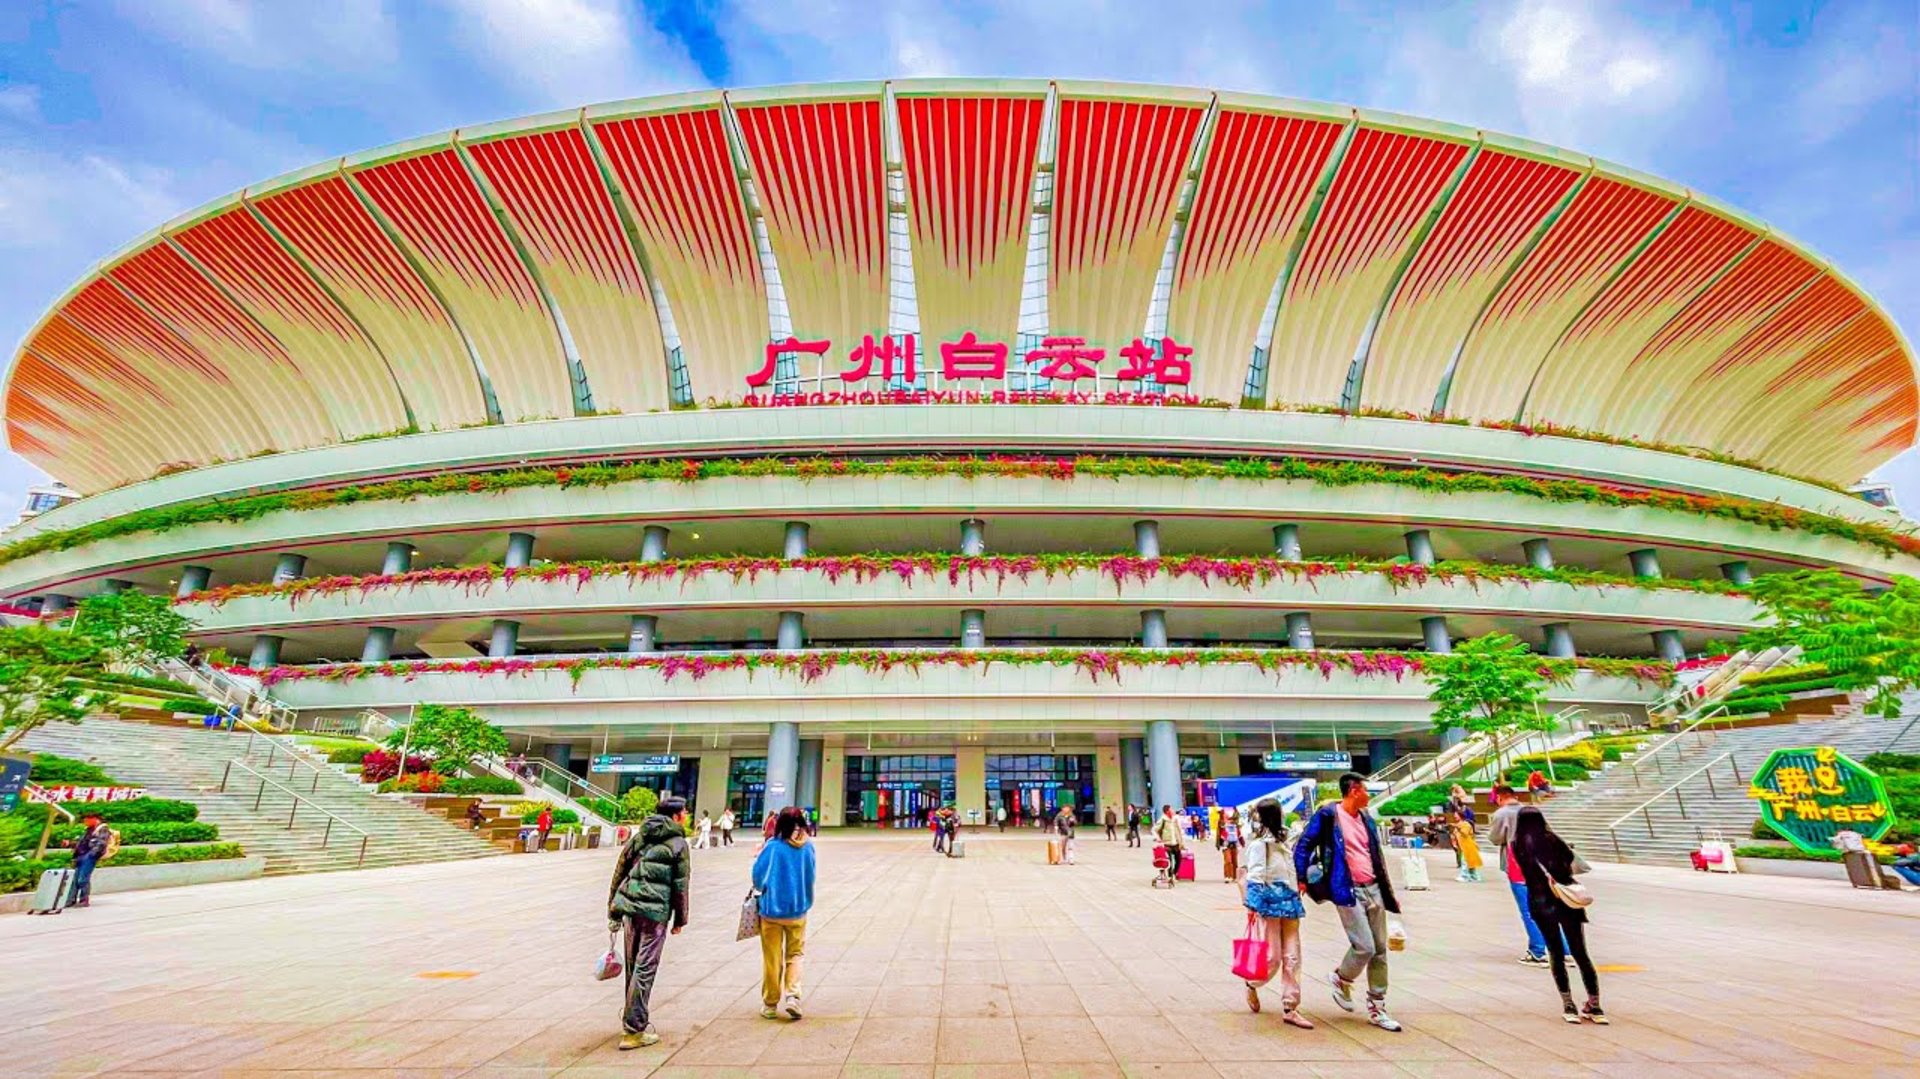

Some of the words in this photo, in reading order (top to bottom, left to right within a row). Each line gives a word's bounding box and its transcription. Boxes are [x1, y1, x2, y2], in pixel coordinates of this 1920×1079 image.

[745, 330, 1193, 386] 广州白云站
[1103, 391, 1200, 406] STATION
